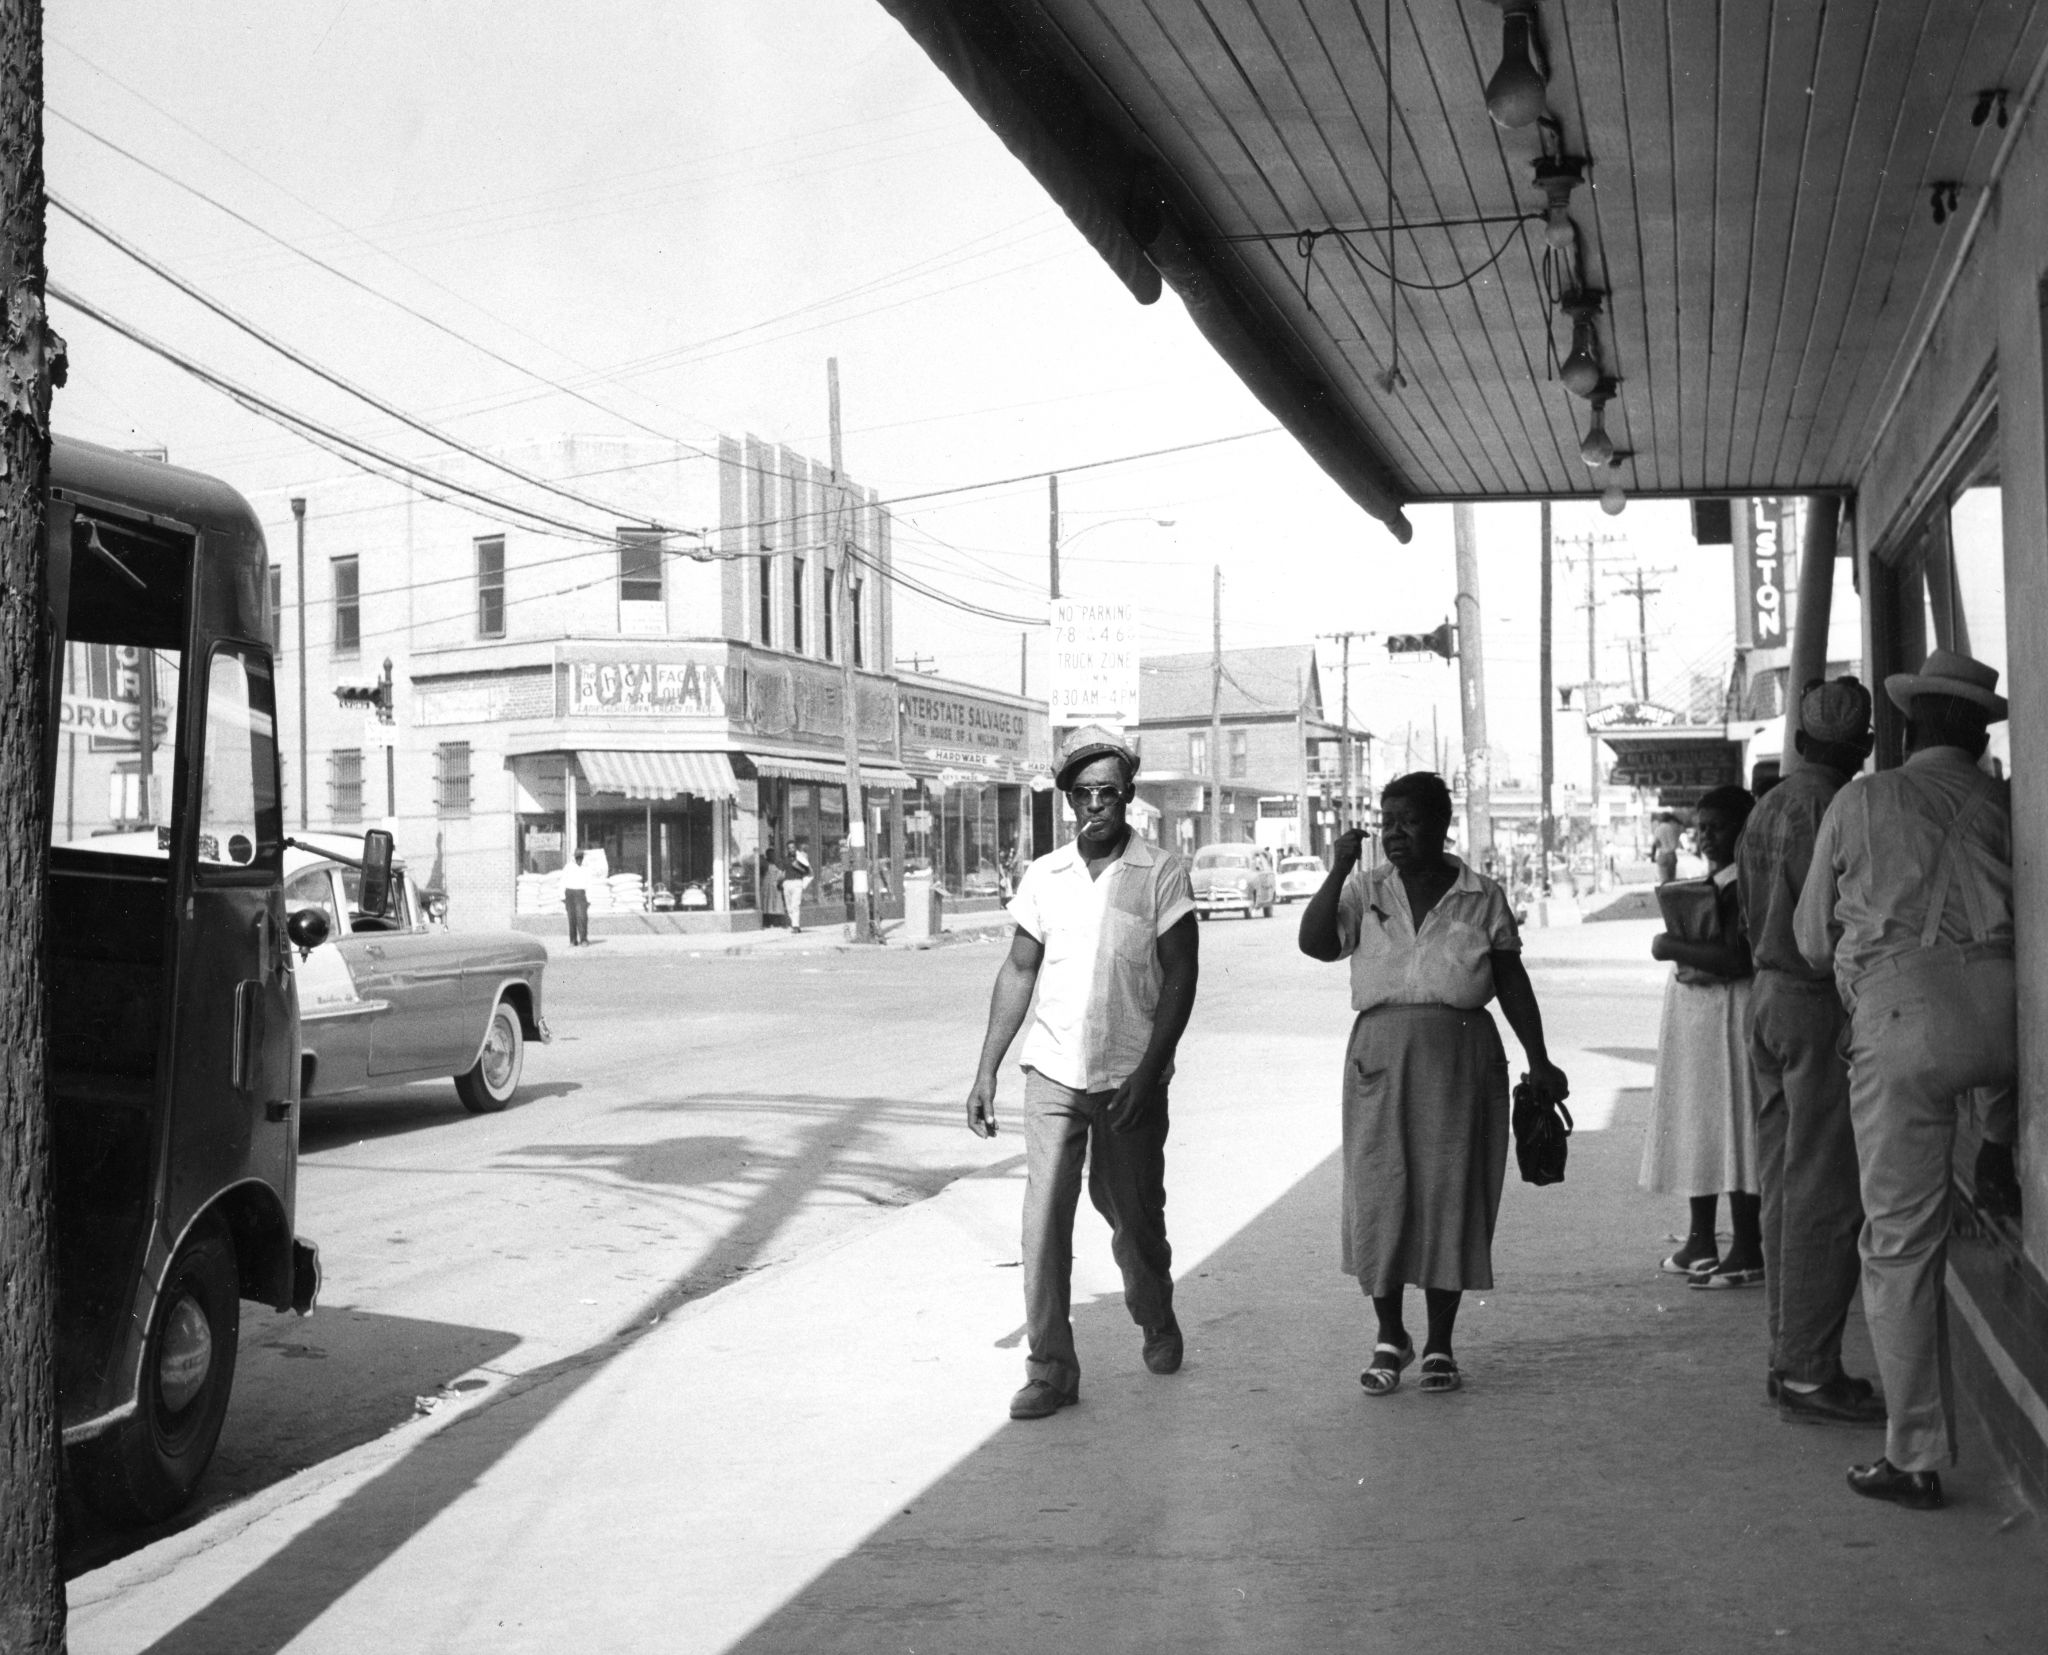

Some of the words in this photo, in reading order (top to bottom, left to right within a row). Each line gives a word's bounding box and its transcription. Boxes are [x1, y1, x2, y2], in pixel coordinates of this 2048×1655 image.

[1752, 497, 1780, 640] LSTON
[1059, 606, 1074, 621] NO
[1082, 604, 1132, 620] PARKING
[1058, 652, 1094, 669] TRUCK
[1101, 652, 1132, 669] ZONE
[968, 706, 1011, 734] SALVAGE
[935, 750, 988, 764] HARDWARE
